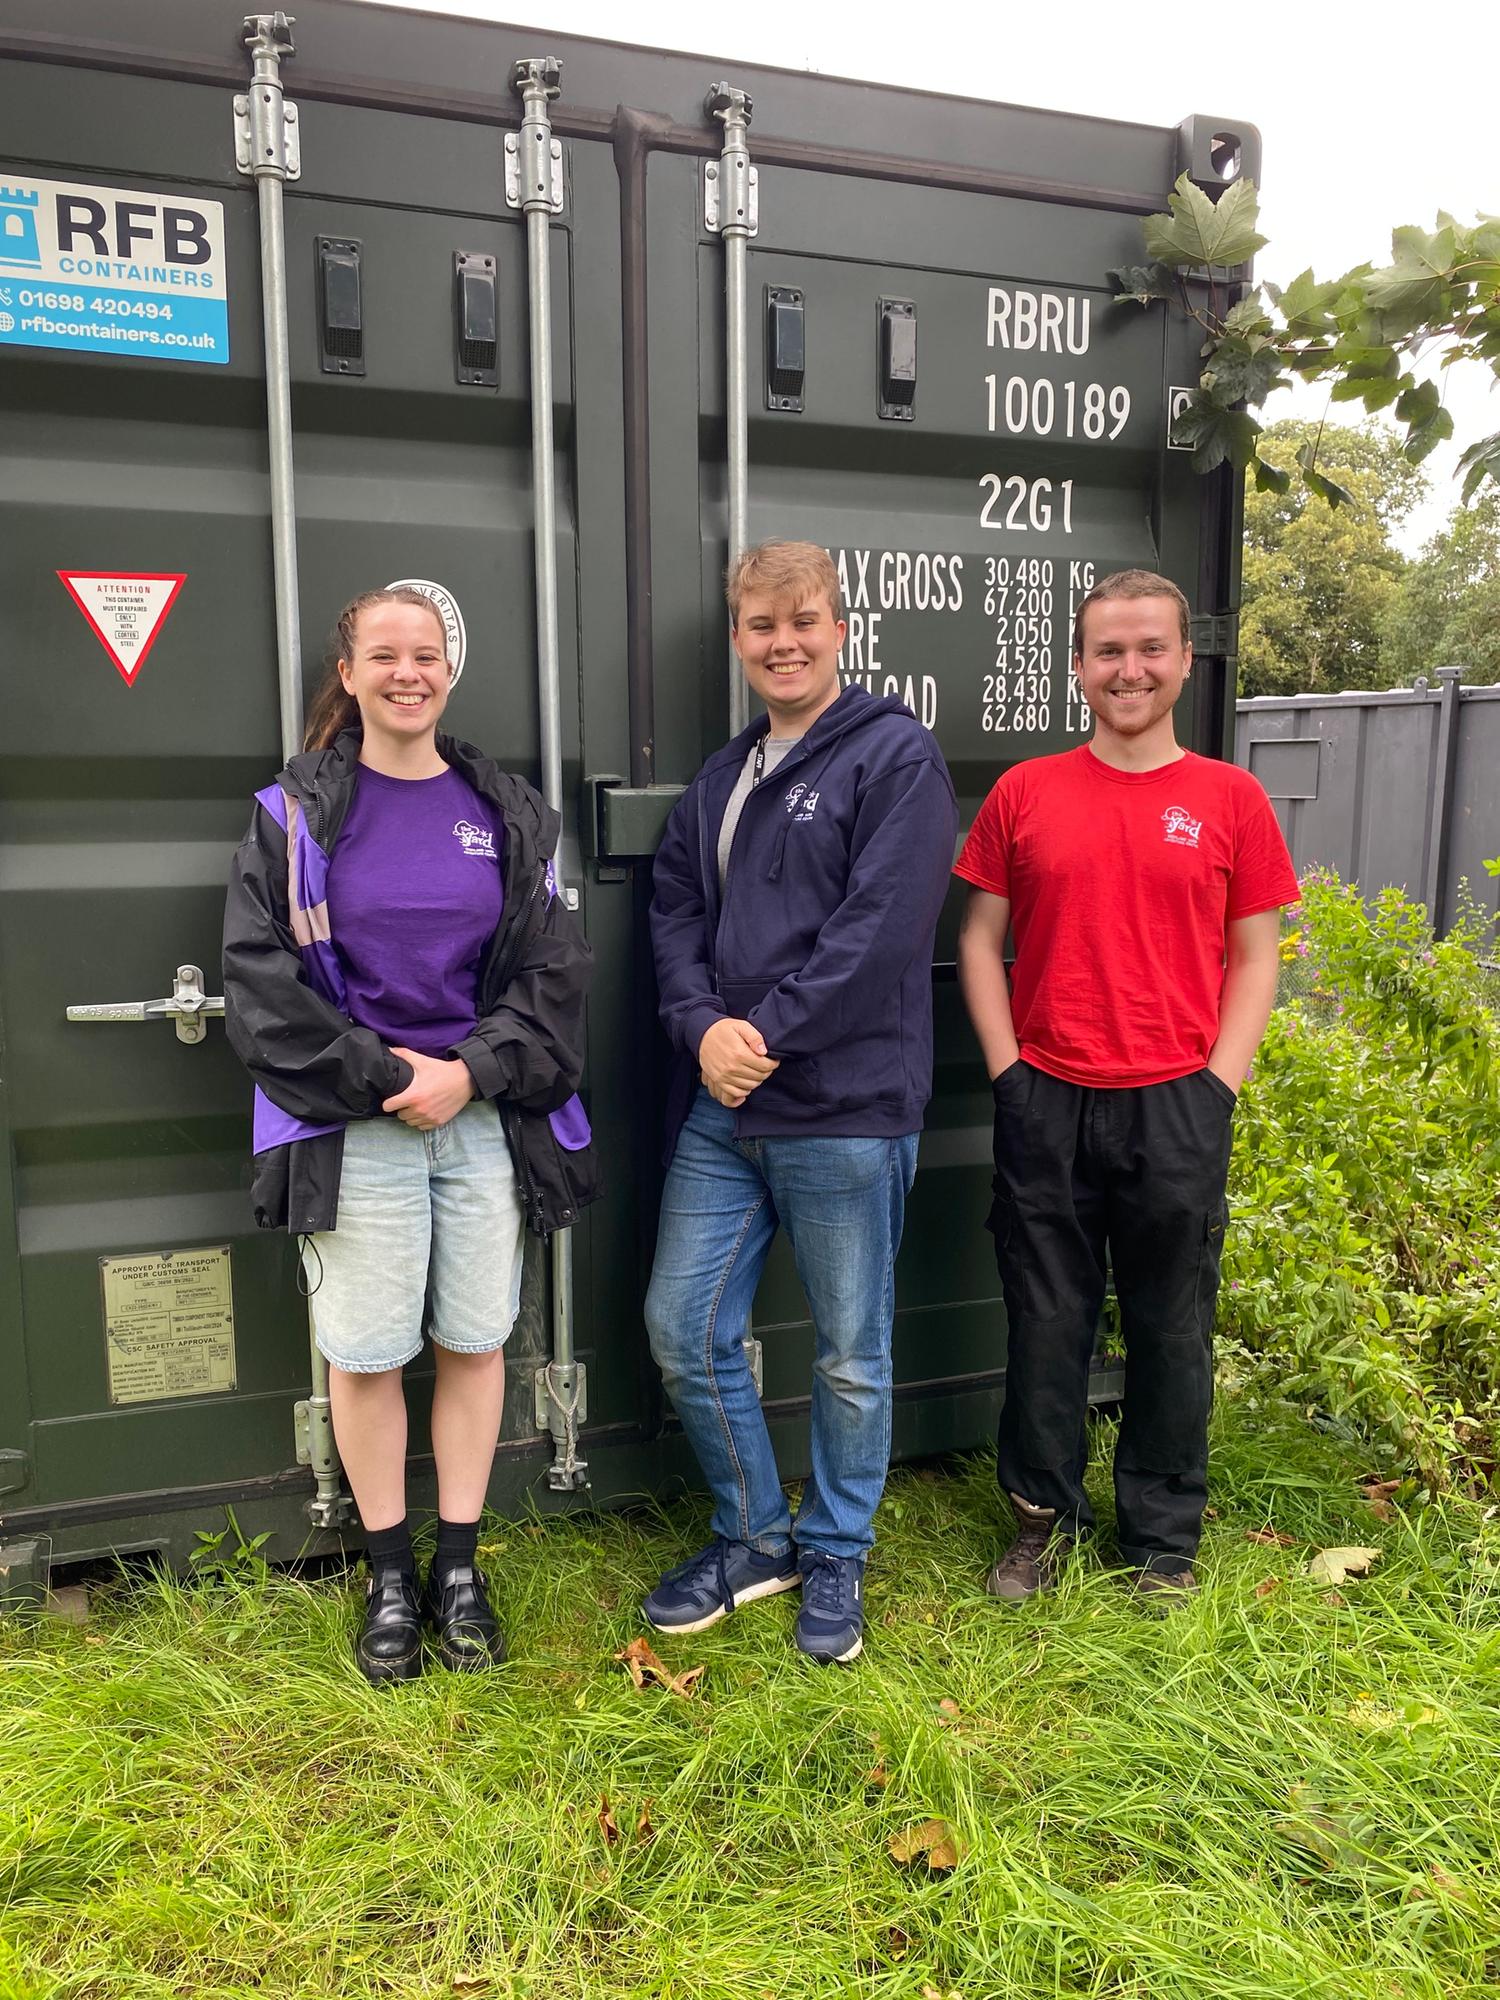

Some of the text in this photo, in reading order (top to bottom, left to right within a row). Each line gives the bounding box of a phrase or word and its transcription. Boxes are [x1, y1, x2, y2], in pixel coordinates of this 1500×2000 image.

[56, 194, 212, 265] RFB
[59, 257, 213, 288] CONTAINERS
[19, 290, 173, 320] 01698 420494
[21, 316, 215, 349] rfbcontainers.co.uk
[987, 287, 1090, 355] RBRU
[985, 374, 1131, 440] 100189
[979, 473, 1073, 533] 22G1
[97, 585, 151, 594] ATTENTION
[826, 549, 964, 611] AX GROSS
[1069, 561, 1095, 590] KG
[837, 612, 882, 670] RE
[1066, 704, 1091, 732] LB
[112, 1264, 154, 1274] APPROVED
[176, 1258, 220, 1268] TRANSPORT
[153, 1269, 188, 1277] CUSTOMS
[146, 1342, 175, 1351] SAFETY
[179, 1337, 218, 1346] APPROVAL
